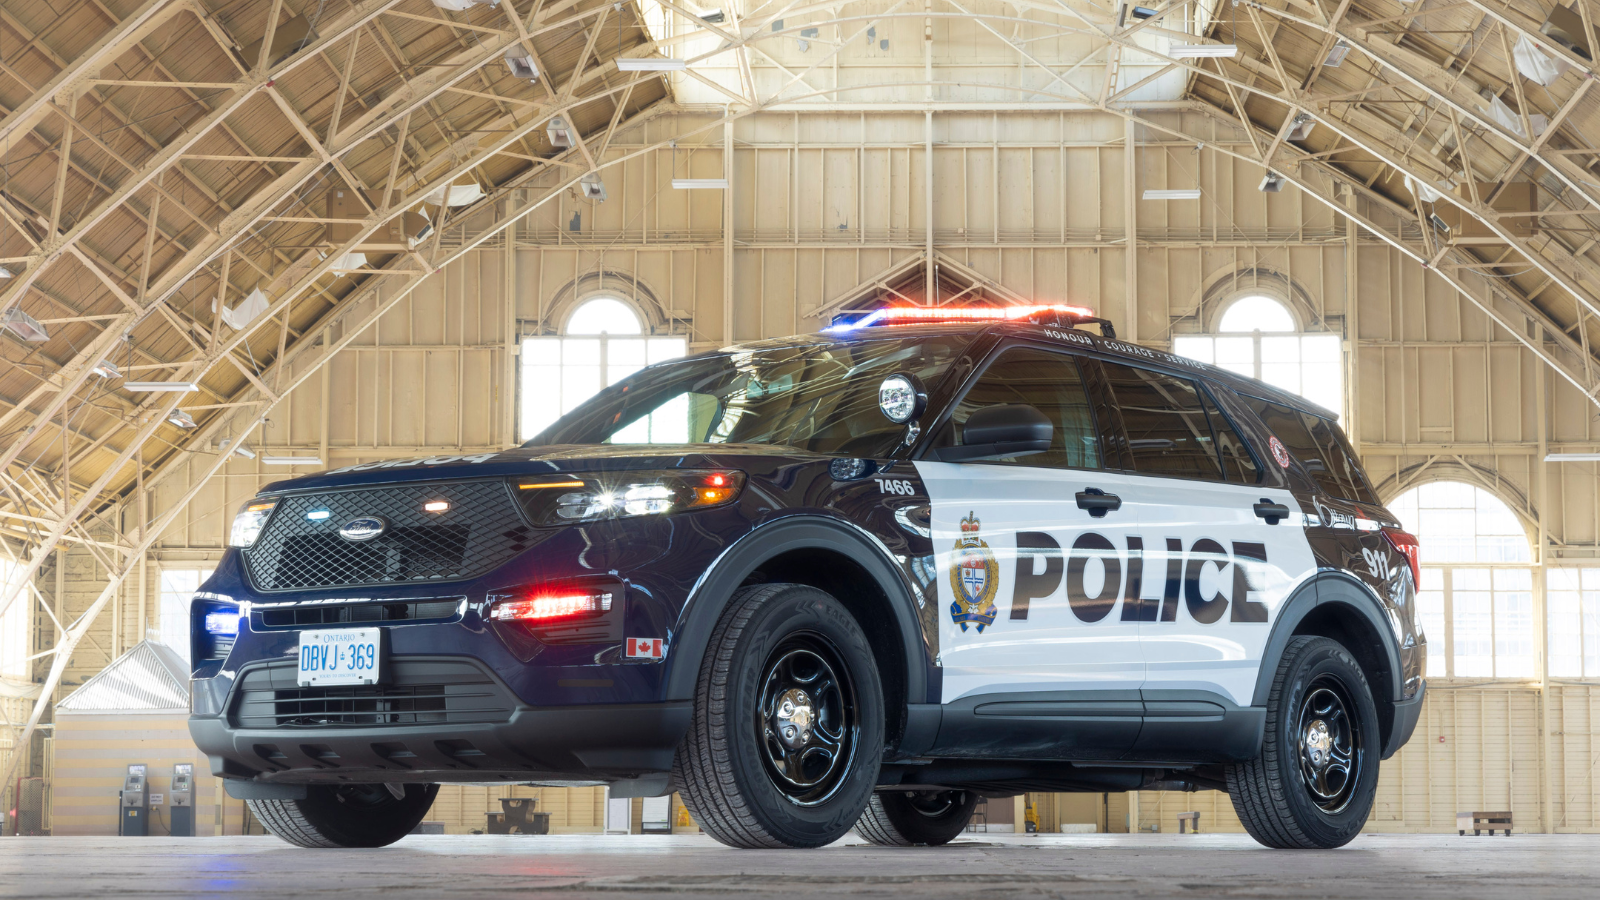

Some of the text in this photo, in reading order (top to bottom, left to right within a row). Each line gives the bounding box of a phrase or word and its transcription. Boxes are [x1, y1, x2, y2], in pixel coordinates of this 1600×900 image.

[1044, 328, 1207, 371] HONOUR COURAGE SERVICE
[874, 478, 915, 496] 7466
[1008, 530, 1270, 624] POLICE
[1362, 547, 1390, 581] 911
[825, 604, 858, 637] EAGLE
[323, 633, 356, 643] ONTARIO
[301, 642, 375, 671] DBVJ 369
